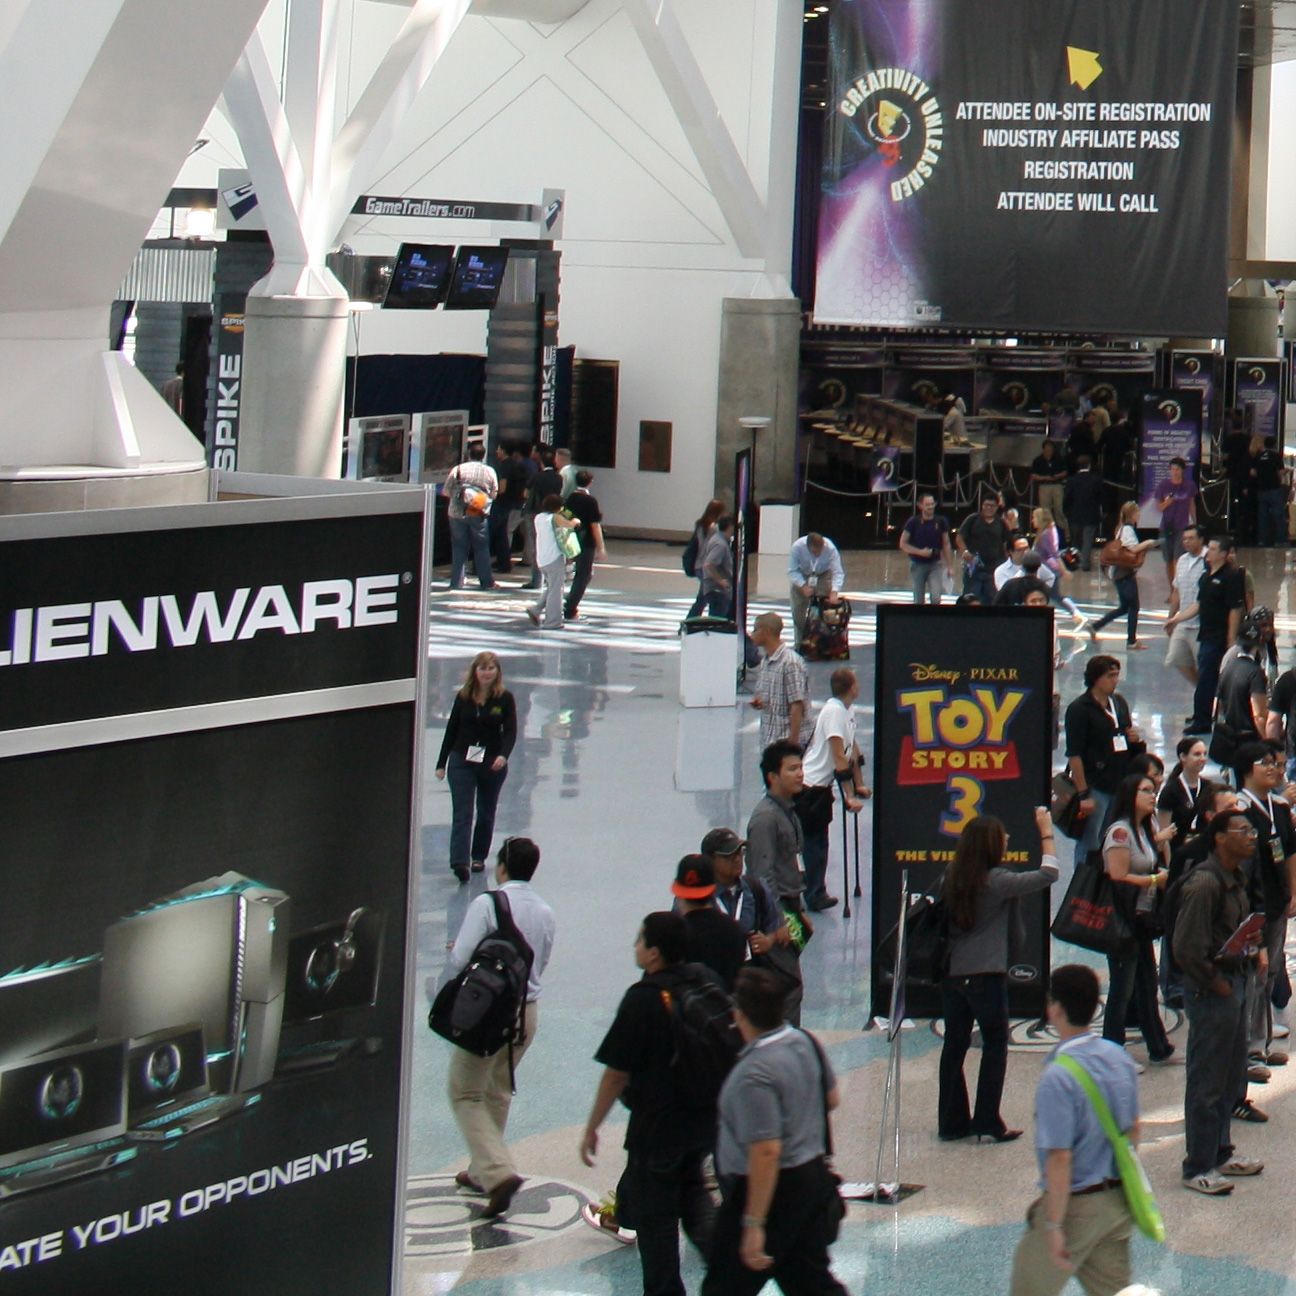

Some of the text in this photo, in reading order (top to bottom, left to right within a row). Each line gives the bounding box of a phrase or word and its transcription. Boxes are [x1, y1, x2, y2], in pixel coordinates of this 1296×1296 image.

[955, 102, 1211, 122] ATTENDEE ON-SITE REGISTRATION
[840, 68, 943, 201] CREATIVITY UNLEASHED
[982, 129, 1180, 149] INDUSTRY AFFILIATE PASS
[1024, 161, 1133, 180] REGISTRATION
[366, 197, 475, 218] GameTrailers.com
[997, 193, 1158, 213] ATTENDEE WILL CALL
[214, 354, 241, 472] SPIKE
[0, 573, 399, 669] IENWARE
[909, 663, 1019, 685] Disney PIXAR
[898, 685, 1030, 747] TOY
[912, 751, 1009, 769] STORY
[942, 773, 983, 836] 3
[895, 850, 927, 861] THE
[70, 1199, 172, 1251] YOUR
[179, 1137, 375, 1220] OPPONENTS.
